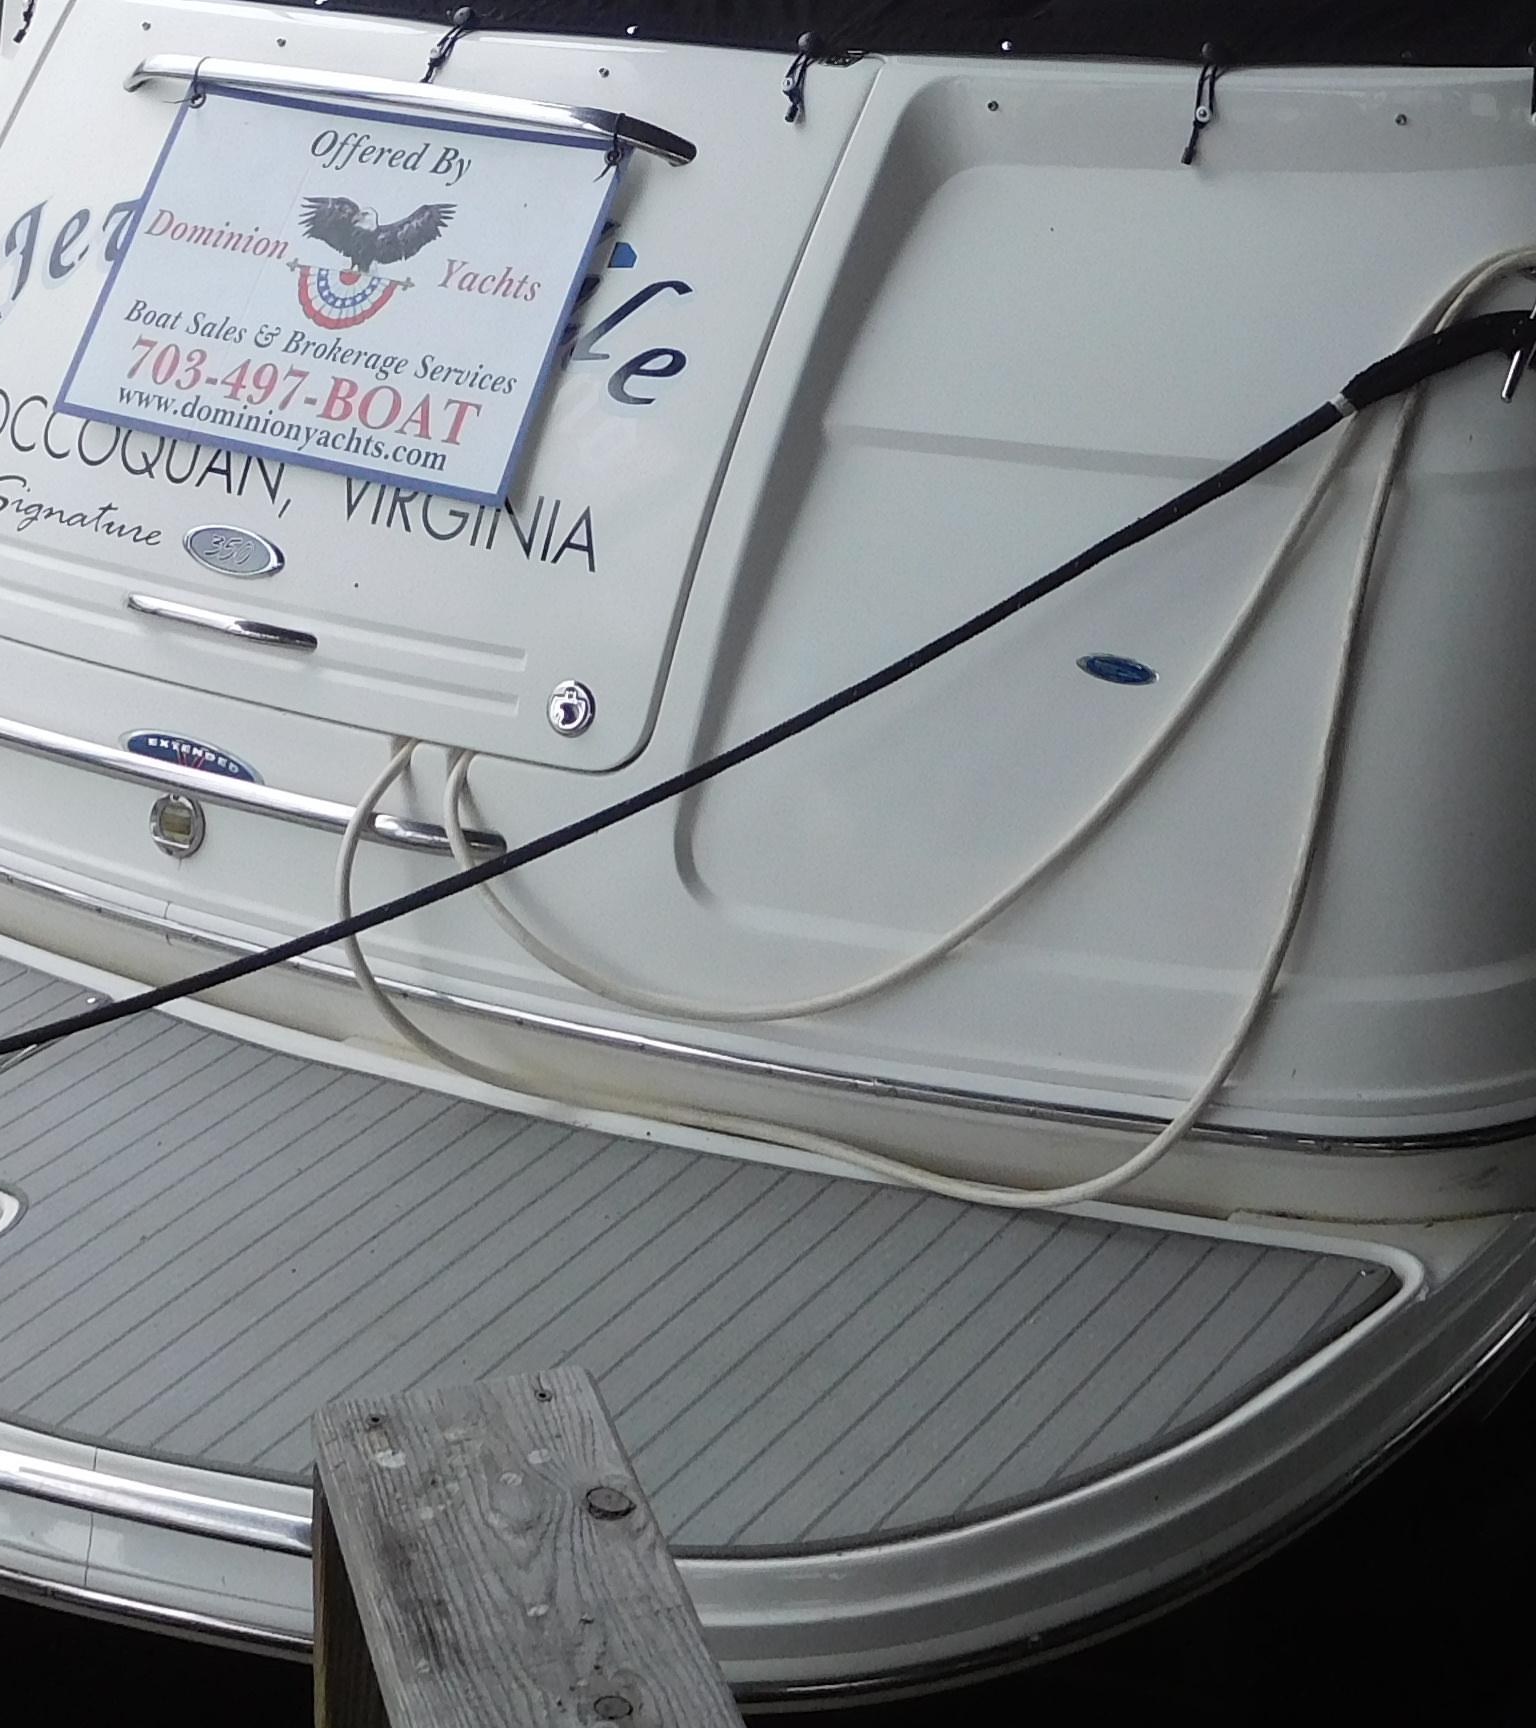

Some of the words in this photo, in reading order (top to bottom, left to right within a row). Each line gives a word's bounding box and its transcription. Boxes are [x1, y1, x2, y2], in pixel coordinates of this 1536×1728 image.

[311, 129, 430, 171] Offered
[430, 146, 472, 187] By
[144, 208, 289, 260] Dominion
[437, 258, 542, 302] Yachts
[124, 299, 183, 330] Boat
[185, 311, 248, 344] Sales
[254, 324, 282, 348] &
[282, 329, 409, 381] Brokerage
[413, 354, 518, 395] Services
[126, 333, 483, 446] 703-497-BOAT
[118, 385, 448, 471] www.dominionyachts.com
[204, 535, 255, 565] 350
[346, 476, 596, 572] VIRGINIA
[147, 737, 240, 773] EXTENDED
